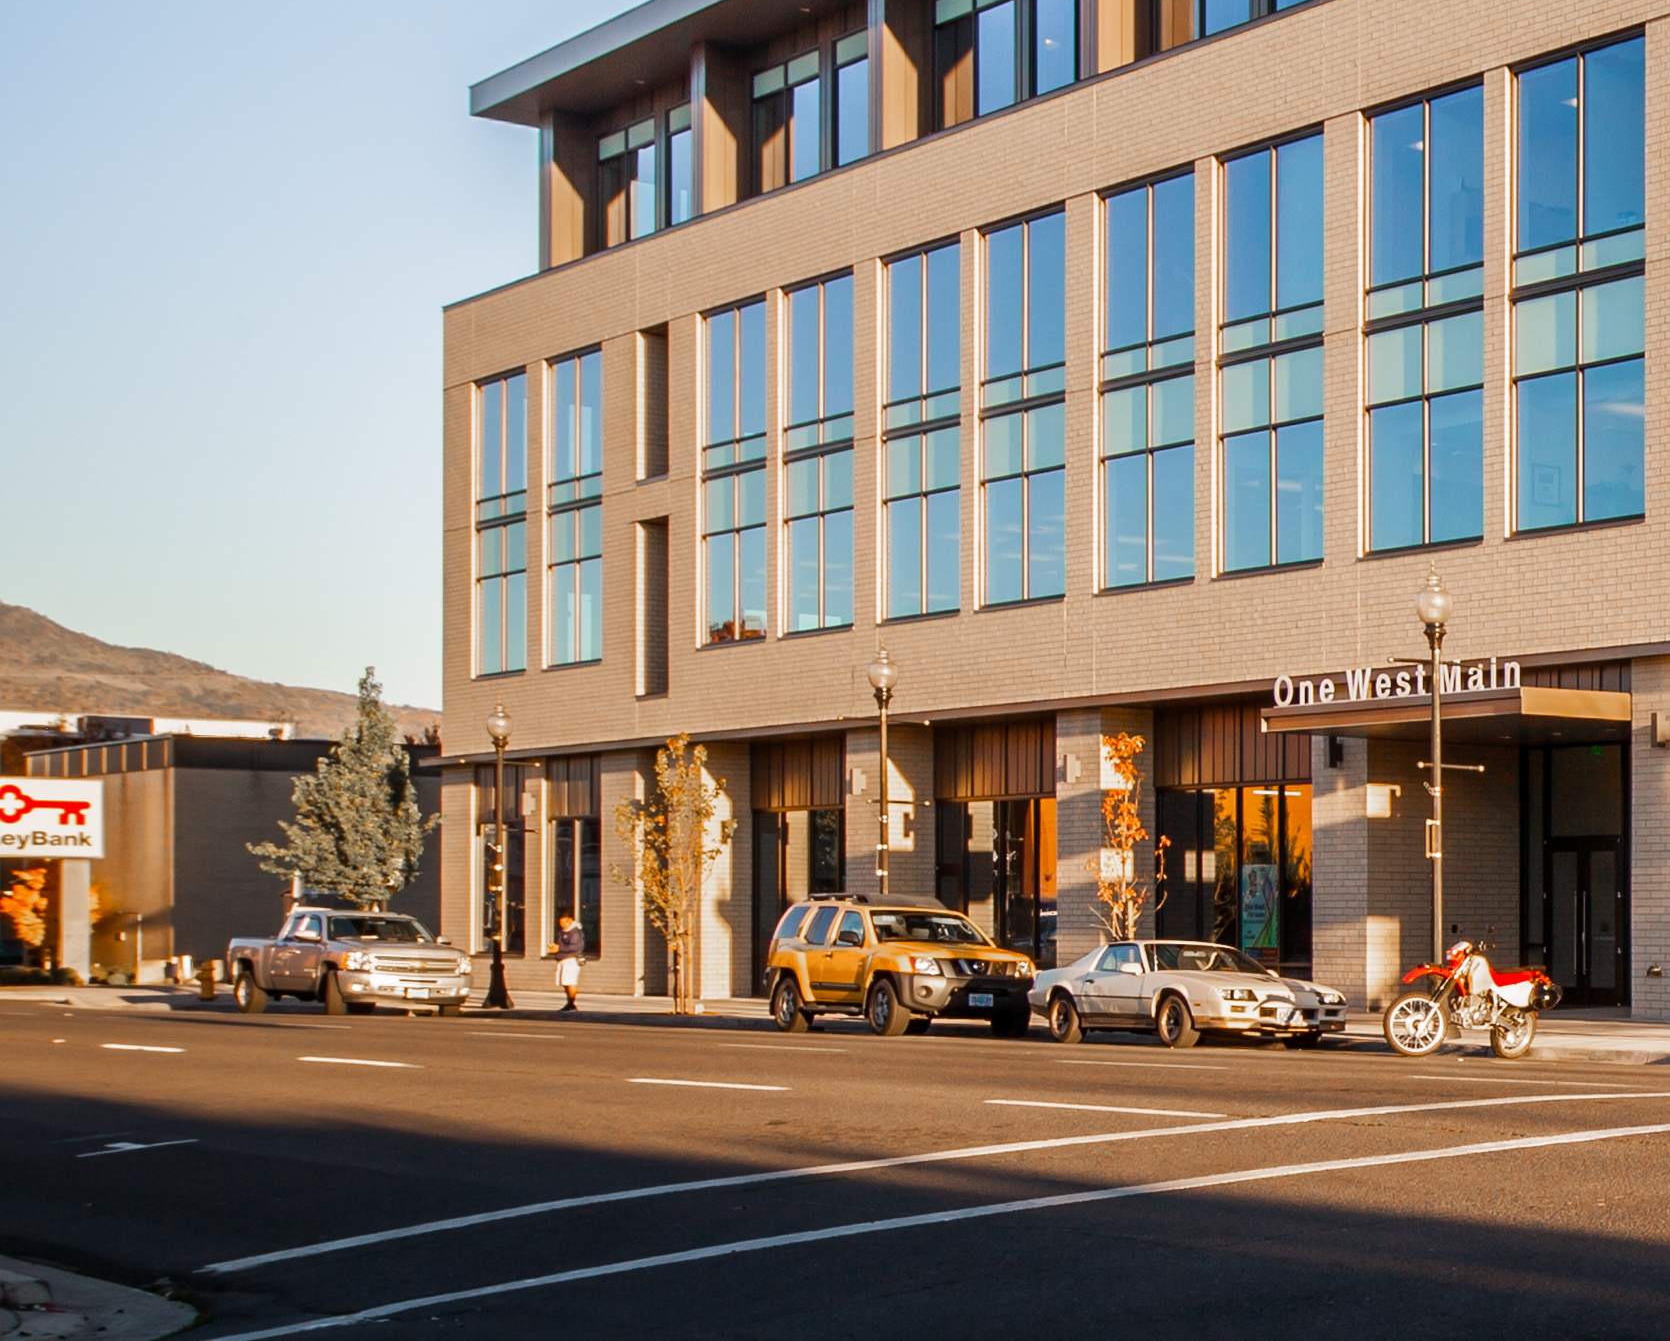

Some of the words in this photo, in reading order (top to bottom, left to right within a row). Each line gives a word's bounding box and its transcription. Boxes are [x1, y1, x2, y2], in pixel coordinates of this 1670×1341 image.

[1273, 674, 1335, 707] One
[1345, 666, 1426, 699] West
[1438, 657, 1521, 694] Main
[0, 830, 93, 850] eyBank
